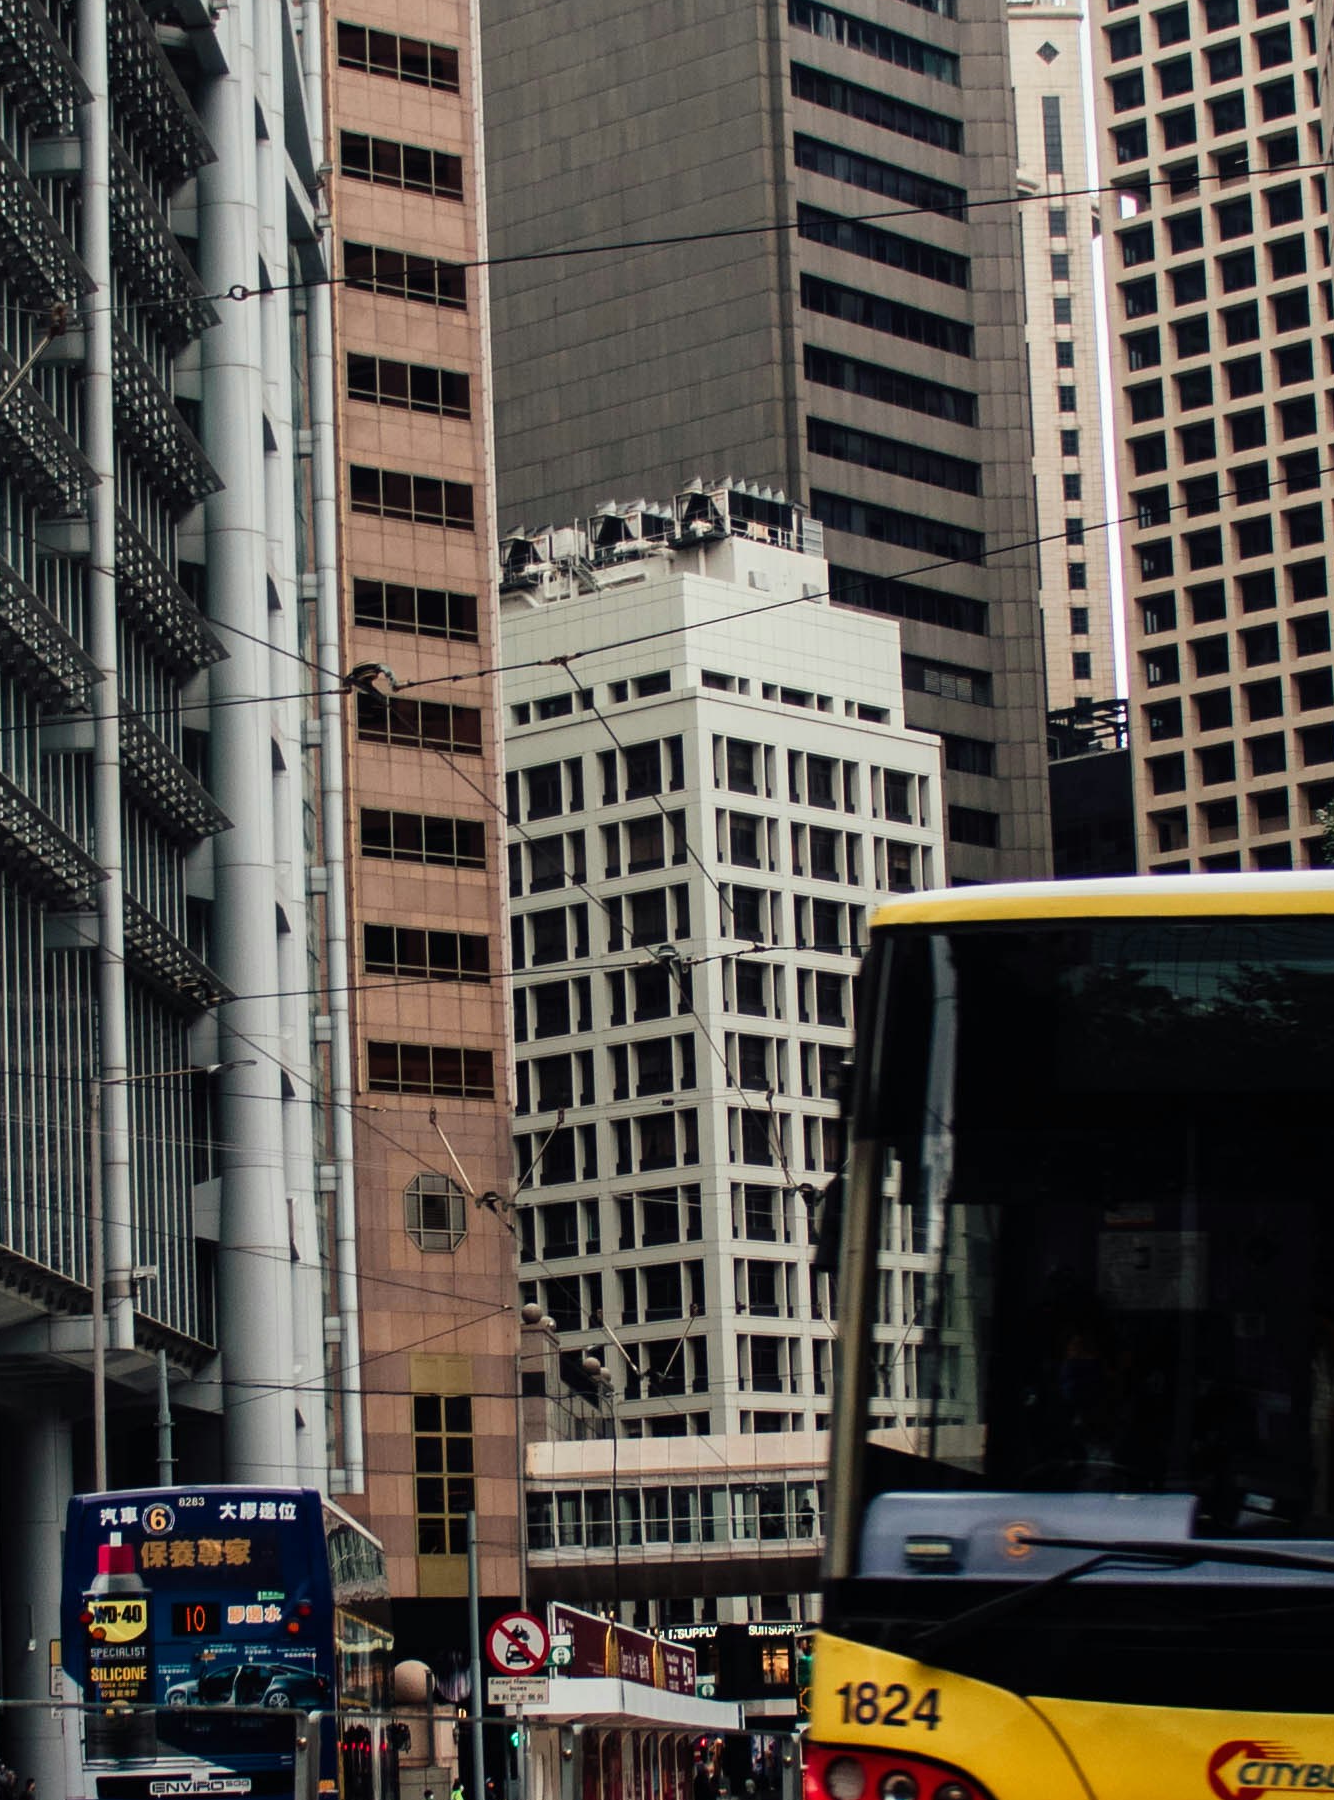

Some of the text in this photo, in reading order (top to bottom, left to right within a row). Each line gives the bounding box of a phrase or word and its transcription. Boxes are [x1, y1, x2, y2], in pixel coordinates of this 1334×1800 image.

[178, 1497, 206, 1507] 8283
[100, 1506, 138, 1526] 汽車
[150, 1508, 167, 1531] 6
[140, 1538, 252, 1569] 保養專家
[186, 1605, 206, 1632] 10
[91, 1647, 147, 1658] SPECIALIST
[91, 1666, 147, 1682] SILICONE
[836, 1681, 941, 1730] 1824
